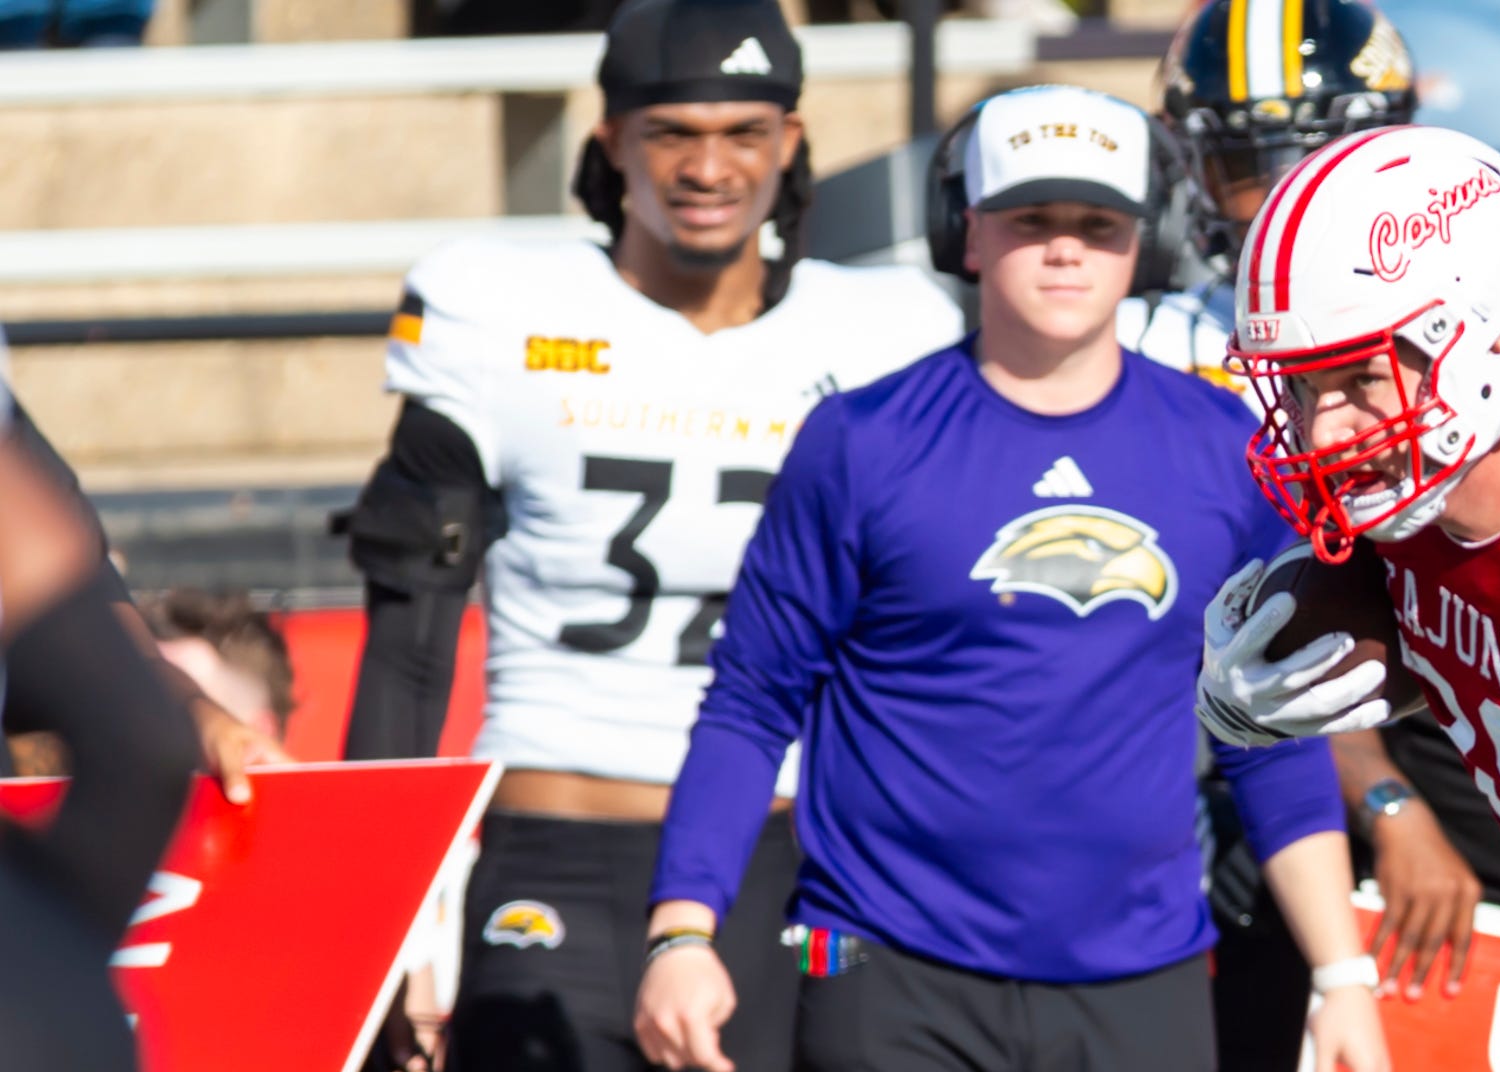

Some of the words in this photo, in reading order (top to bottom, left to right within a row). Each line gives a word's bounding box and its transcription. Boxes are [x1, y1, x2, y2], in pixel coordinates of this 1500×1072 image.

[1039, 123, 1078, 139] THE
[1246, 318, 1280, 342] 337
[525, 336, 611, 374] SBC
[559, 398, 749, 441] SOUTHERN
